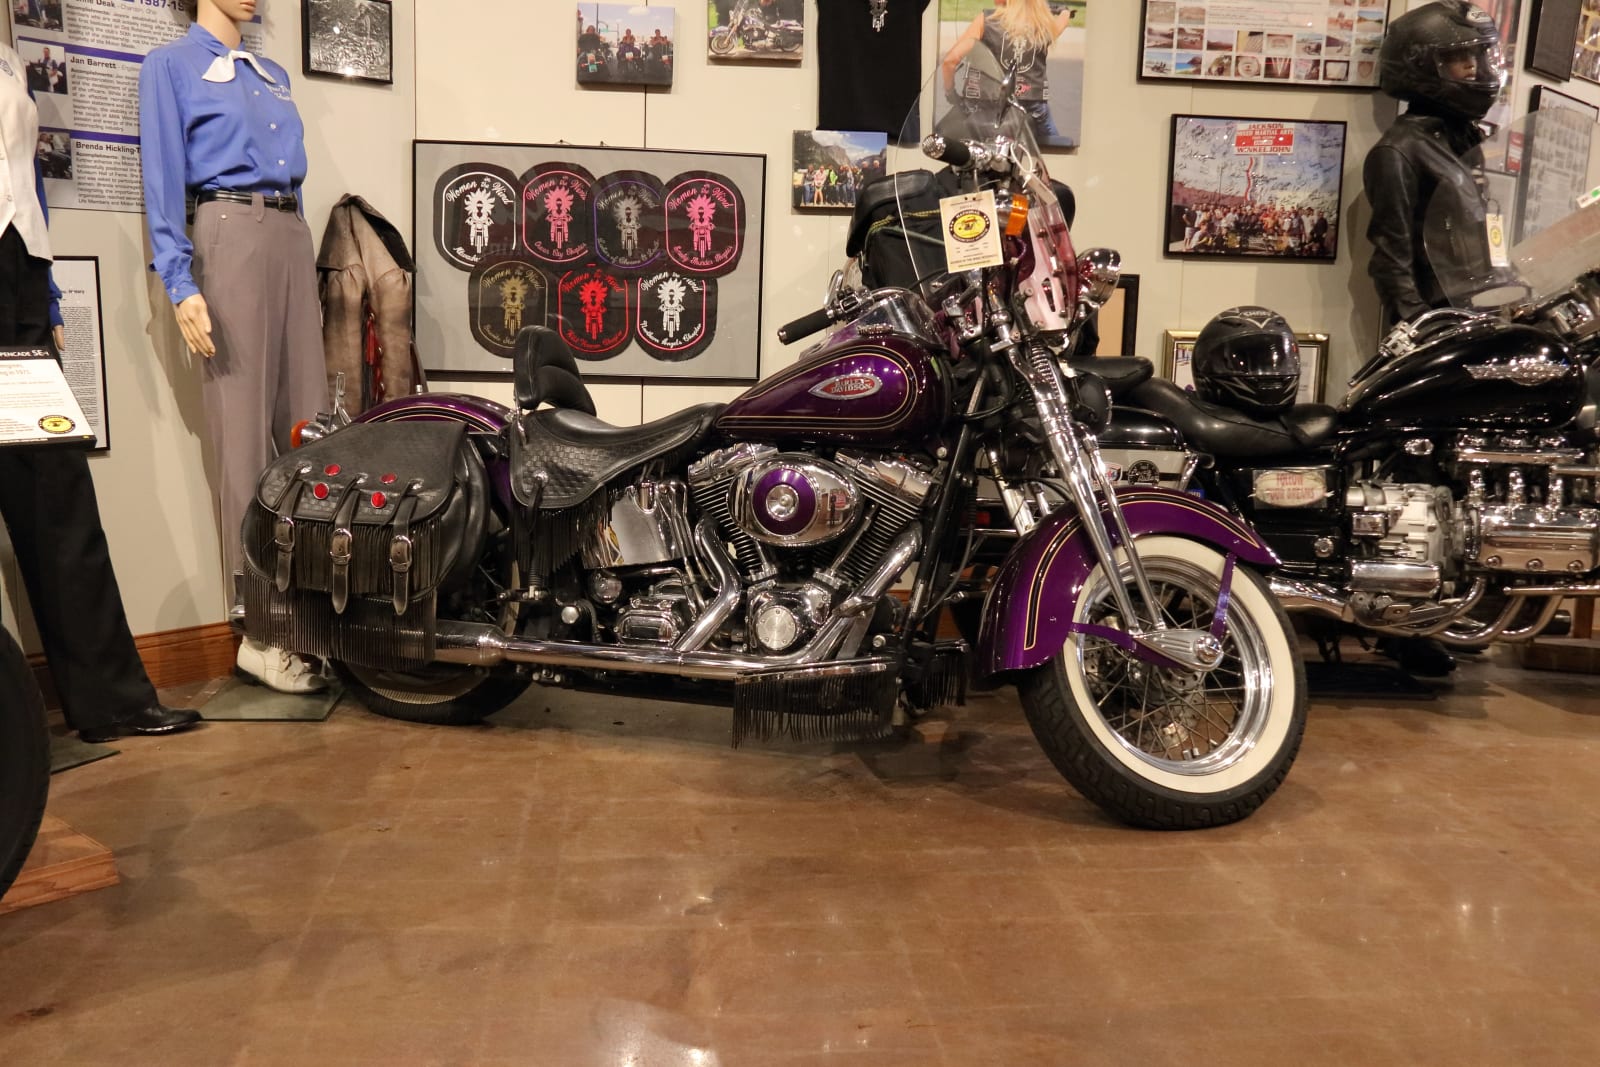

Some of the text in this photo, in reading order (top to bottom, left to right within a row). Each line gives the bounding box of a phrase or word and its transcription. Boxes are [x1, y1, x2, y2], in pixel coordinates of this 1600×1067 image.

[70, 56, 85, 64] Jan
[87, 58, 117, 69] Barrett
[1248, 123, 1284, 131] JACKSON
[75, 141, 104, 151] Brenda
[445, 180, 478, 203] Women
[492, 181, 515, 206] Wind
[525, 179, 556, 201] Women
[596, 188, 625, 211] Women
[667, 187, 698, 210] Women
[712, 186, 735, 209] Wind
[480, 268, 511, 289] Women
[524, 269, 546, 289] Wind
[561, 272, 590, 293] Women
[605, 274, 625, 293] Wind
[640, 271, 669, 292] Women
[683, 277, 704, 293] ind
[661, 337, 683, 349] Angels
[831, 383, 873, 394] DAVIDSON
[1276, 472, 1304, 487] FOLLOW
